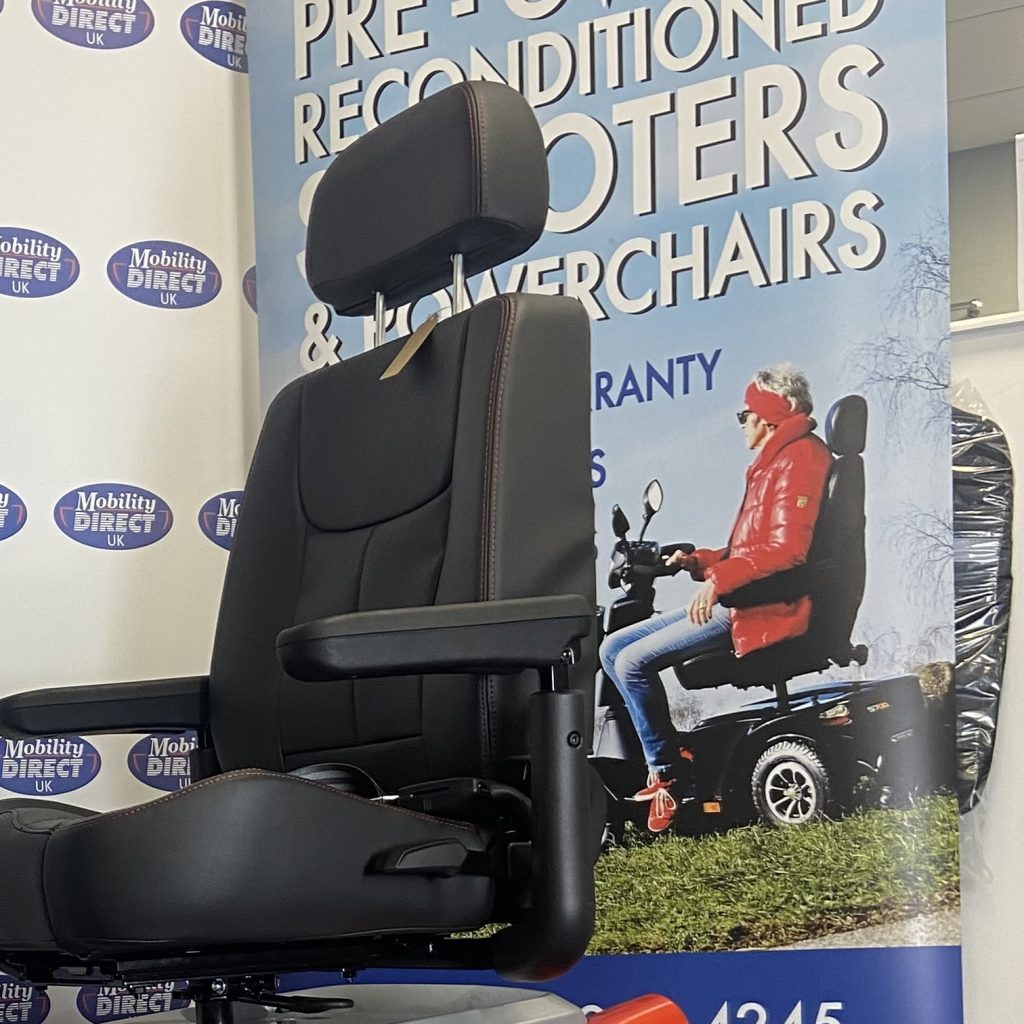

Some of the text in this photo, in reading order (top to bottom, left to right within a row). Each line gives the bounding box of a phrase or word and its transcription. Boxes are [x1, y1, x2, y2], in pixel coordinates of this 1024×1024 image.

[51, 5, 136, 33] DIRECT
[200, 5, 247, 32] Mobil
[86, 31, 104, 46] UK
[198, 25, 245, 55] DIRE
[227, 53, 242, 69] UK
[128, 247, 207, 273] Mobility
[12, 279, 30, 294] UK
[127, 267, 206, 294] DIRECT
[160, 292, 178, 306] UK
[595, 348, 723, 411] RANTY
[74, 491, 156, 513] Mobility
[73, 511, 156, 534] DIRECT
[107, 534, 125, 547] UK
[3, 737, 84, 759] Mobility
[2, 757, 83, 779] DIRECT
[146, 756, 191, 776] DIR
[35, 779, 53, 792] UK
